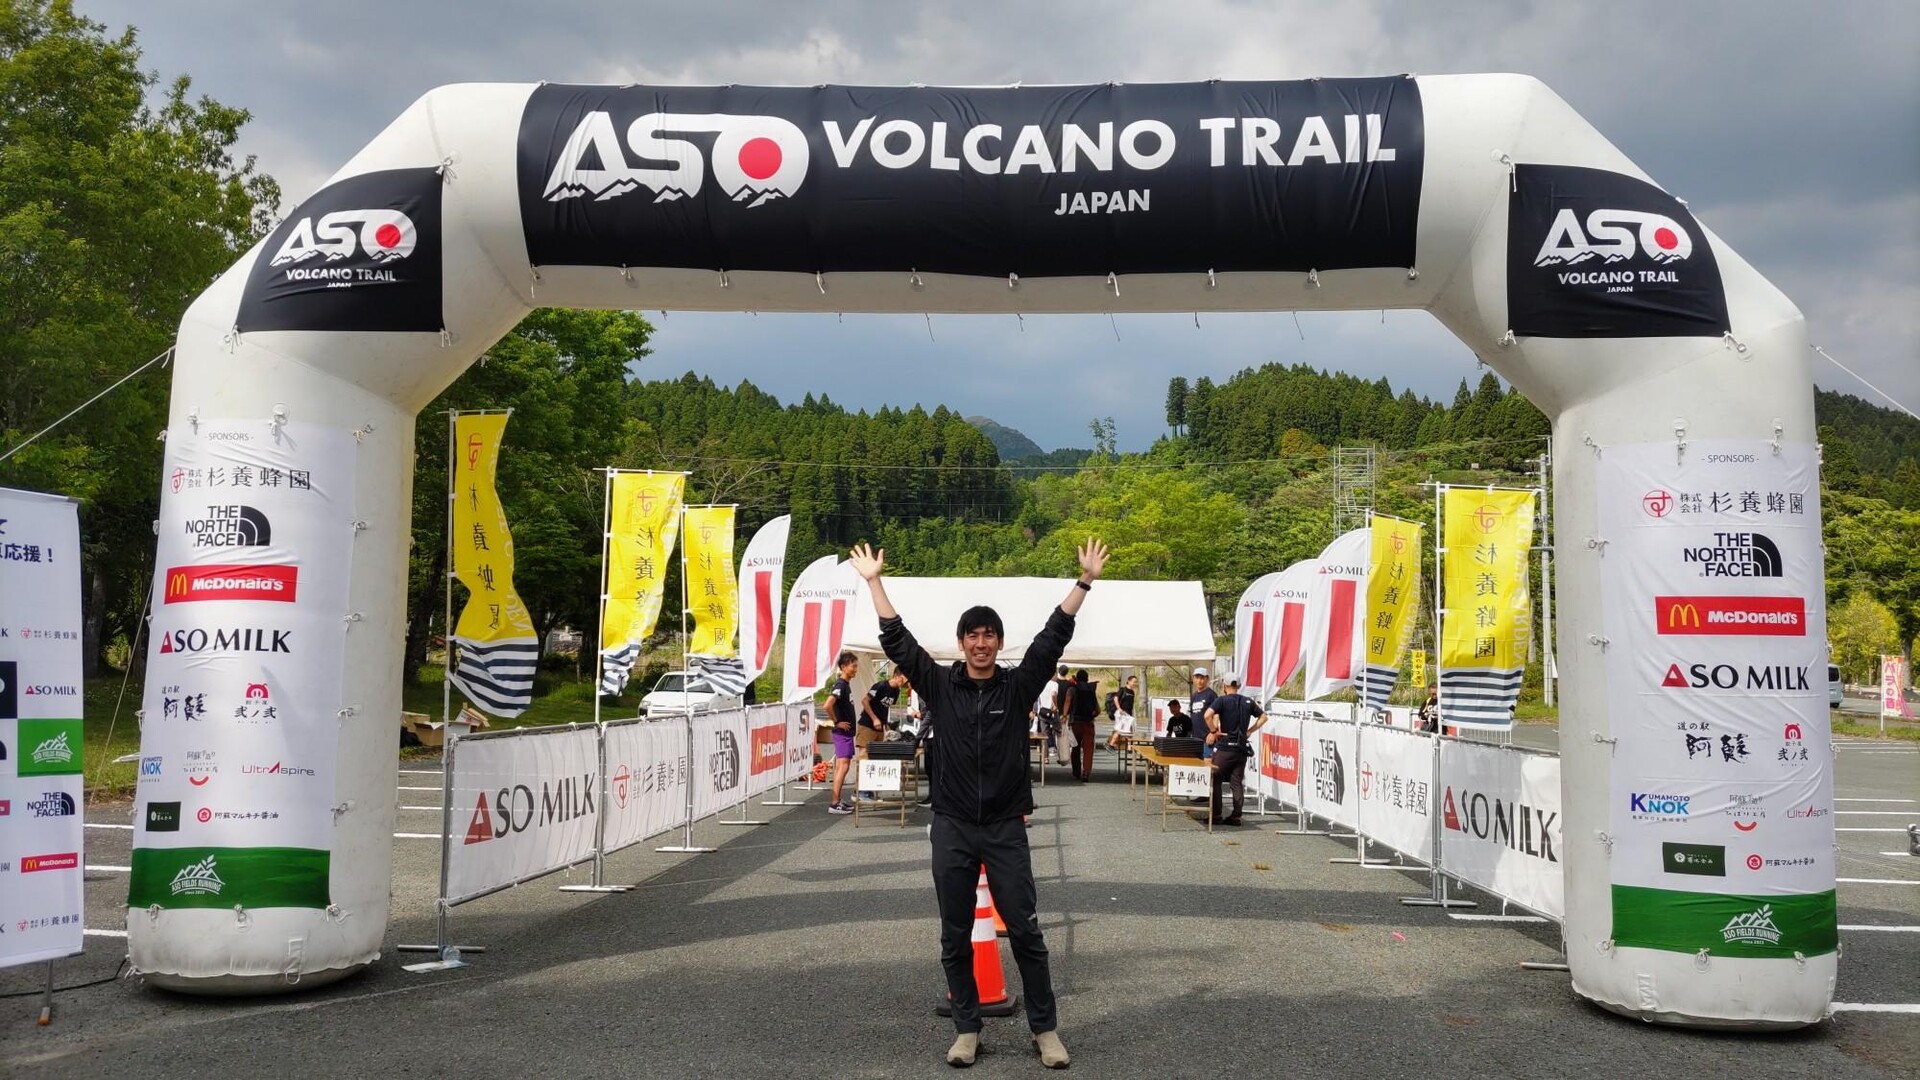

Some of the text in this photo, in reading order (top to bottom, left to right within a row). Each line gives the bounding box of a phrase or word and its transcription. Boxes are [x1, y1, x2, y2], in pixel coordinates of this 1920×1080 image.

[542, 110, 1397, 209] ASO VOLCANO TRAIL
[1054, 188, 1151, 216] JAPAN
[269, 208, 418, 267] ASO
[1533, 208, 1693, 268] ASO
[285, 268, 397, 282] VOLCANO TRAIL
[1557, 270, 1679, 285] VOLCANO TRAIL
[326, 281, 352, 289] JAPAN
[1606, 285, 1634, 293] JAPAN
[207, 466, 310, 490] 杉養蜂園
[1708, 490, 1804, 515] 杉養蜂園
[207, 505, 239, 519] THE
[185, 519, 238, 534] NORTH
[197, 533, 237, 547] FACE
[1714, 533, 1751, 547] THE
[0, 543, 53, 563] 応援！
[1684, 547, 1751, 562] NORTH
[1319, 565, 1344, 575] ASO
[1704, 562, 1752, 577] FACE
[191, 577, 285, 592] McDonald's
[1707, 610, 1798, 625] McDonald's
[160, 628, 292, 654] ASO MILK
[1661, 663, 1810, 691] ASO MILK
[25, 685, 77, 696] ASO MILK
[715, 729, 731, 751] THE
[1319, 738, 1335, 760] THE
[42, 791, 61, 800] THE
[27, 800, 61, 811] NORTH
[36, 808, 61, 817] FACE
[464, 784, 534, 846] ASO
[539, 772, 596, 828] MILK
[1443, 786, 1558, 863] ASO MILK
[1736, 928, 1755, 937] FIELDS
[1755, 928, 1780, 942] RUNNING
